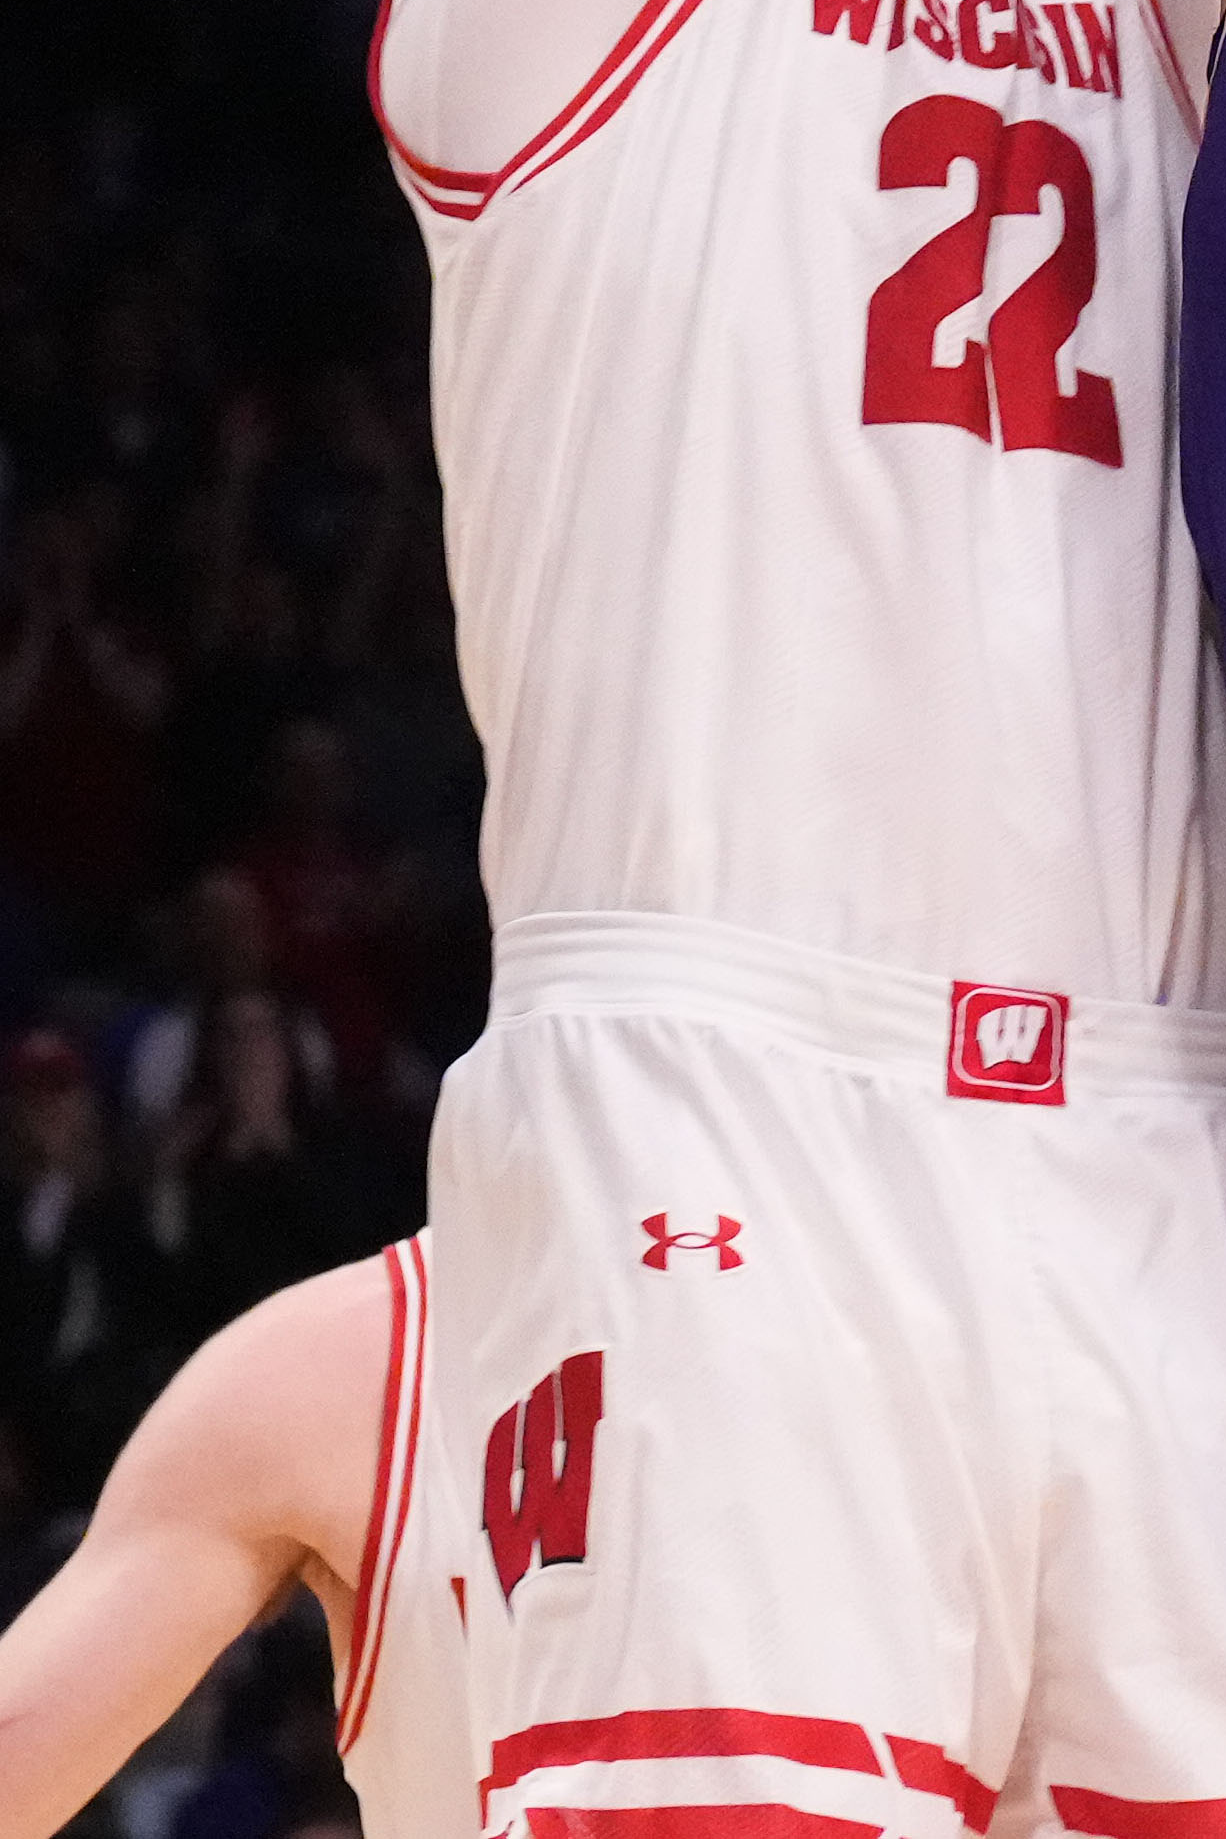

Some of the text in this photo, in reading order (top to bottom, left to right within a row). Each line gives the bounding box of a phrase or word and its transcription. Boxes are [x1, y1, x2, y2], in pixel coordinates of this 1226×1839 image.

[863, 94, 1125, 469] 22
[976, 1004, 1048, 1070] W
[482, 1350, 604, 1606] W
